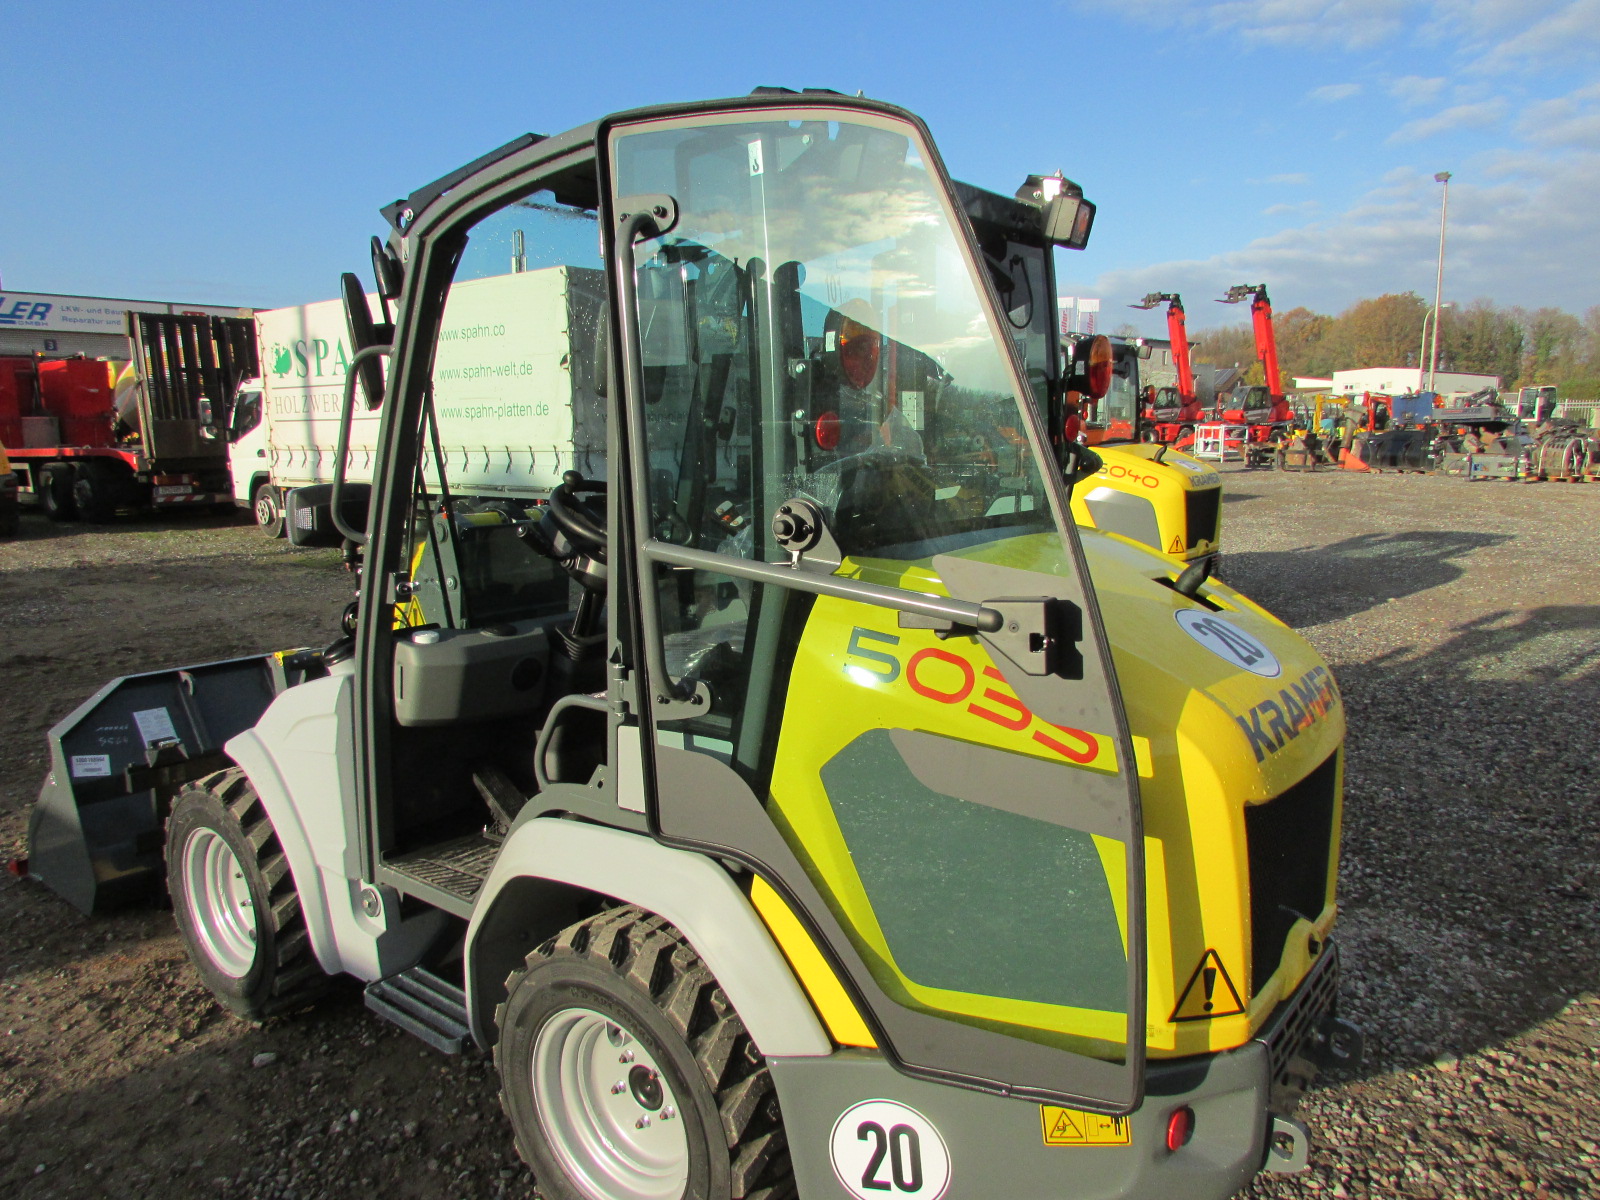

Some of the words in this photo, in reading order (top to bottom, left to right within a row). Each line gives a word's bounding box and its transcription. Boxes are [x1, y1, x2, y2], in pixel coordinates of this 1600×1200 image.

[61, 315, 103, 325] Reparatur
[440, 361, 533, 381] www.spahn-welt.de
[441, 401, 550, 421] www.spahn-platten.de
[1191, 617, 1265, 667] 20
[857, 1120, 924, 1193] 20
